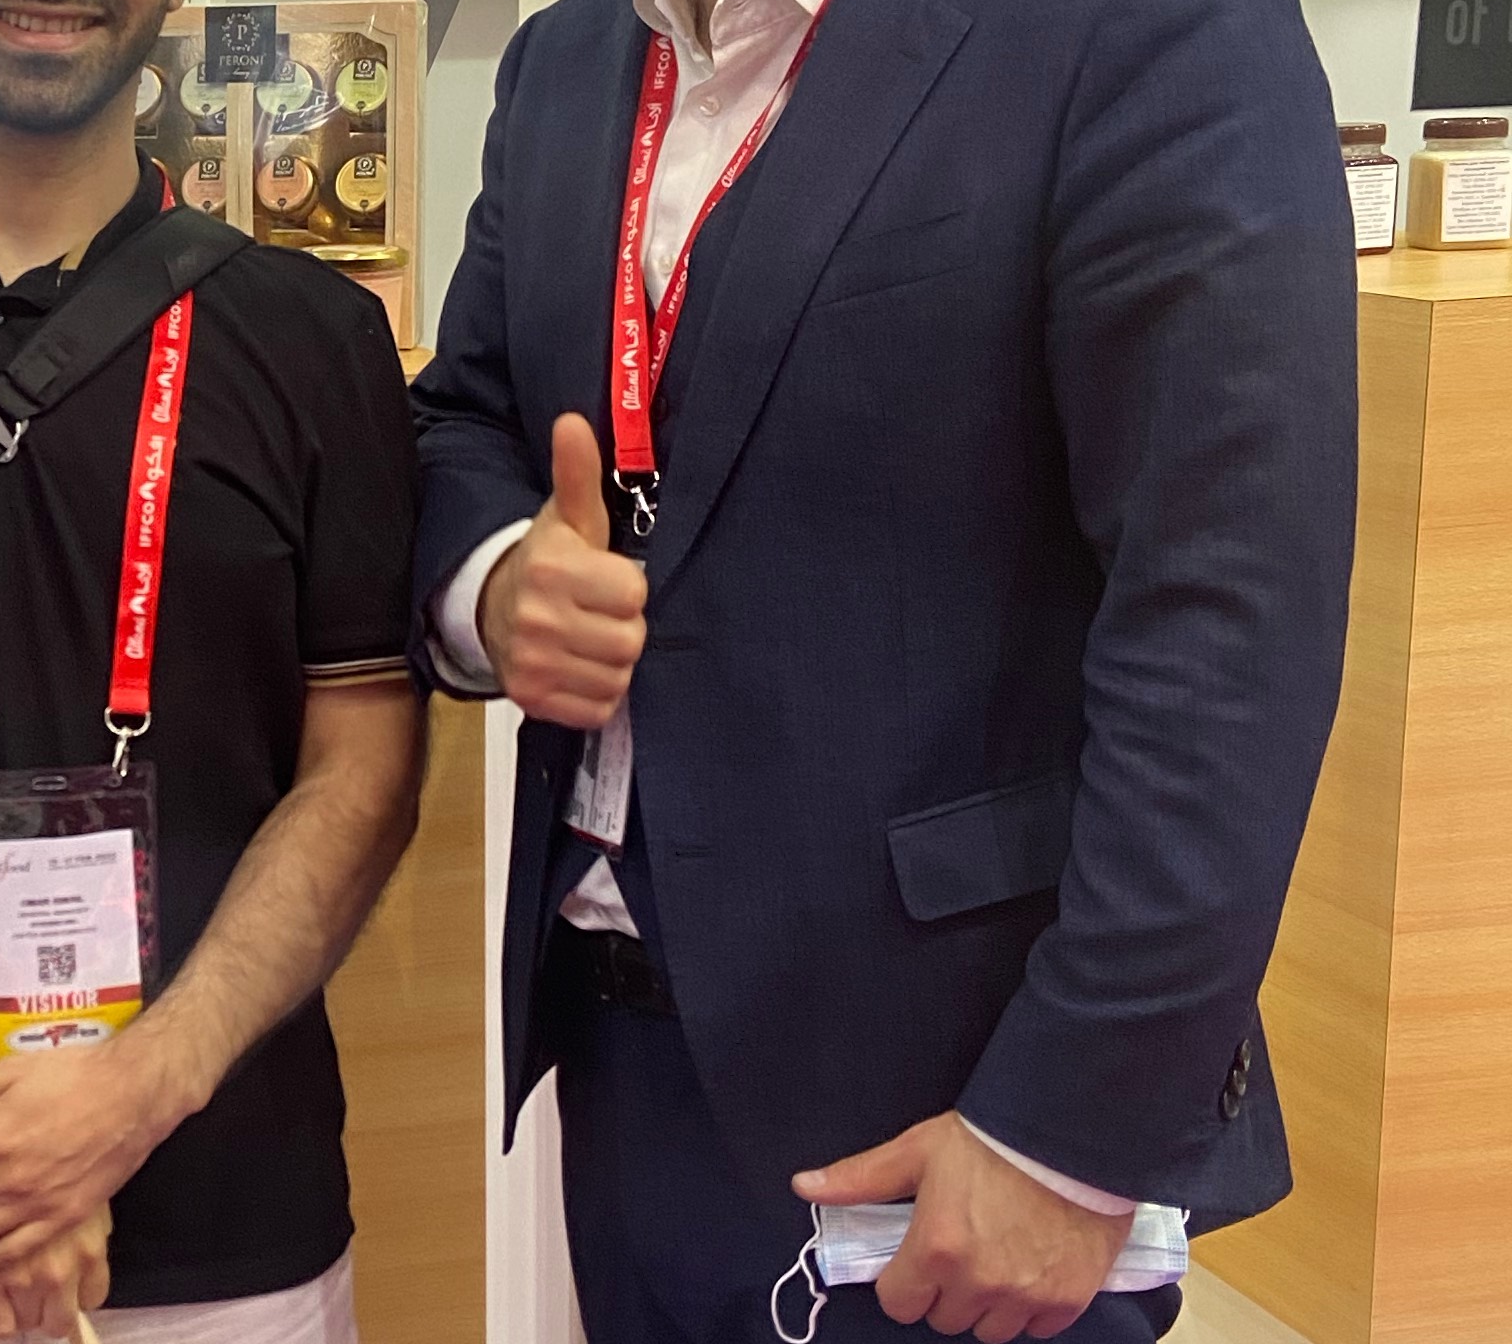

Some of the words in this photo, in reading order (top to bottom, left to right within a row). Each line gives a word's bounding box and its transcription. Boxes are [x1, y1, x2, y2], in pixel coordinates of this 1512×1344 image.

[237, 24, 248, 41] P
[653, 49, 671, 91] IFFCO
[622, 262, 634, 306] IFFCO
[666, 269, 688, 315] IFFCO
[167, 305, 182, 340] IFFCO
[139, 501, 156, 548] IFFCO
[17, 988, 99, 1015] VISITOR
